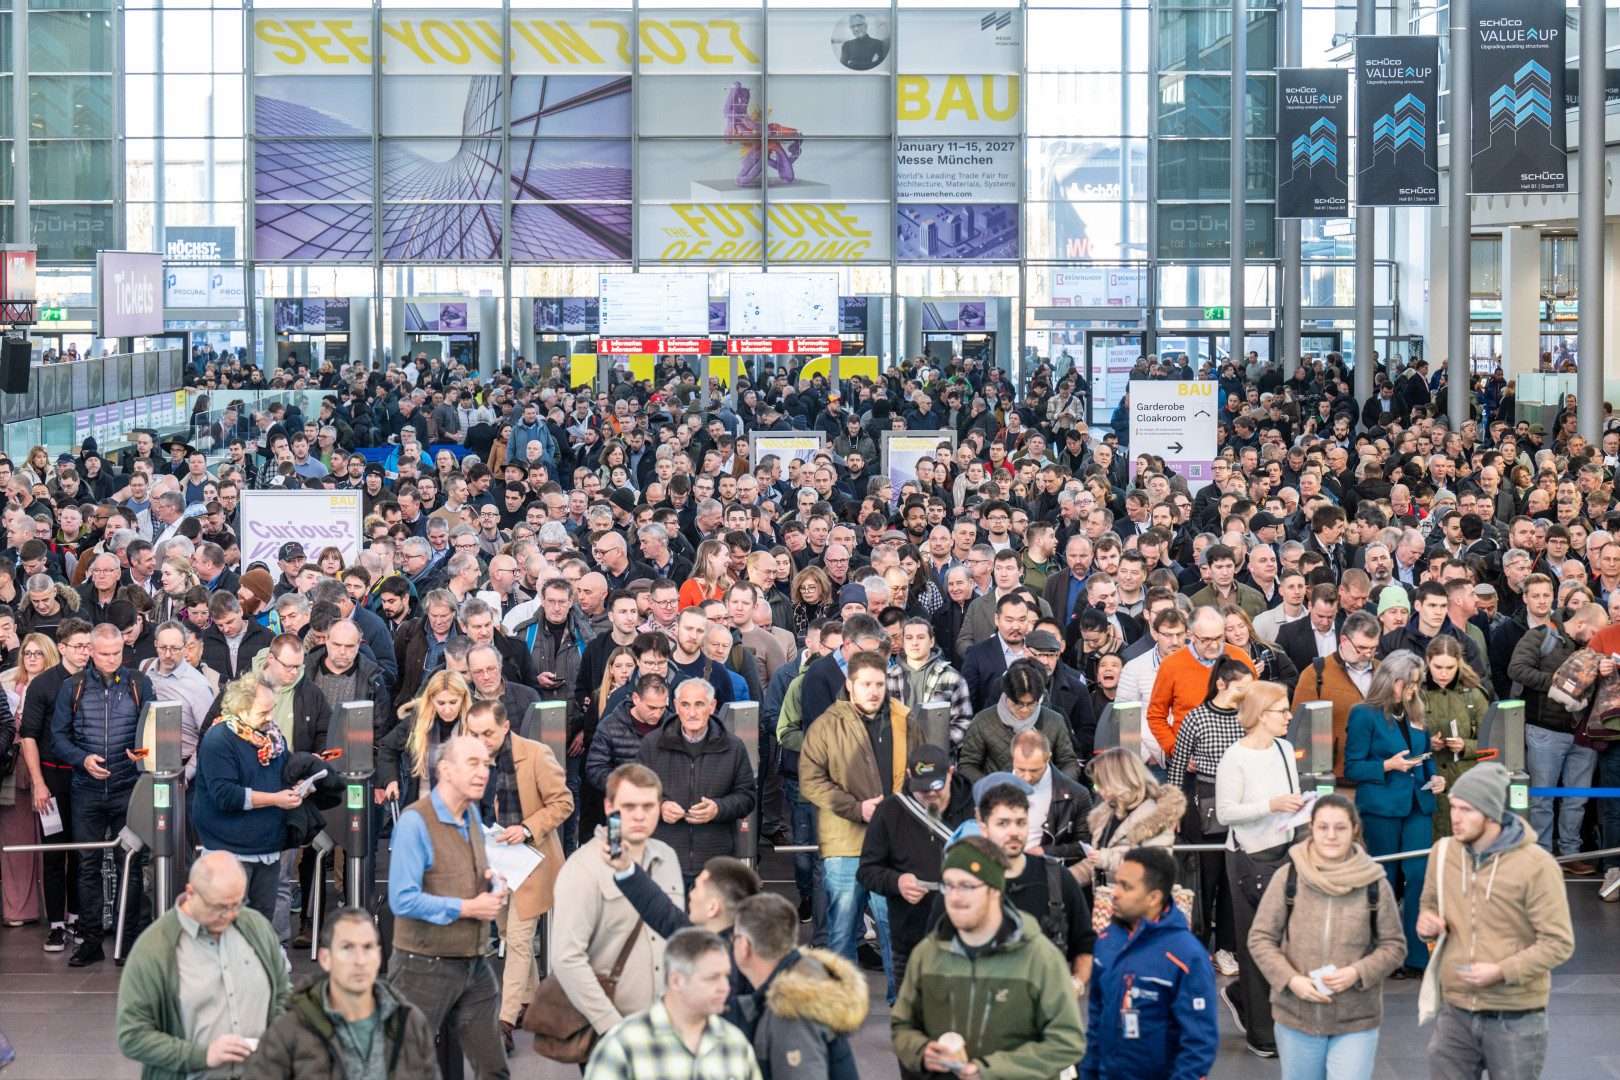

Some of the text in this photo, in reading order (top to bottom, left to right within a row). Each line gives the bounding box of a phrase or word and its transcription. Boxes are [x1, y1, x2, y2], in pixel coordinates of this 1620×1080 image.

[1480, 18, 1522, 26] SCHÜCO
[1480, 29, 1558, 41] VALUE UP
[255, 19, 762, 65] SEE YOU IN 2027
[1366, 58, 1402, 66] SCHÜCO
[1366, 67, 1432, 78] VALUE UP
[897, 75, 1019, 121] BAU
[1286, 95, 1342, 104] VALUE UP
[896, 142, 1015, 153] January 11–15, 2027
[896, 155, 993, 165] Messe München
[926, 172, 956, 180] Leading
[1520, 171, 1564, 180] SCHÜCO
[896, 180, 1016, 189] Architecture, Materials, Systems
[1399, 186, 1436, 194] SCHÜCO
[660, 204, 872, 238] THE FUTURE
[167, 239, 221, 255] HÖCHST-
[660, 240, 872, 264] OF BUILDING
[114, 270, 153, 315] Tickets
[1178, 383, 1212, 396] BAU
[1136, 403, 1185, 411] Garderobe
[1136, 414, 1186, 422] Cloakroom
[759, 439, 818, 449] WELCOME
[331, 496, 356, 506] BAU
[248, 520, 354, 539] Curious?
